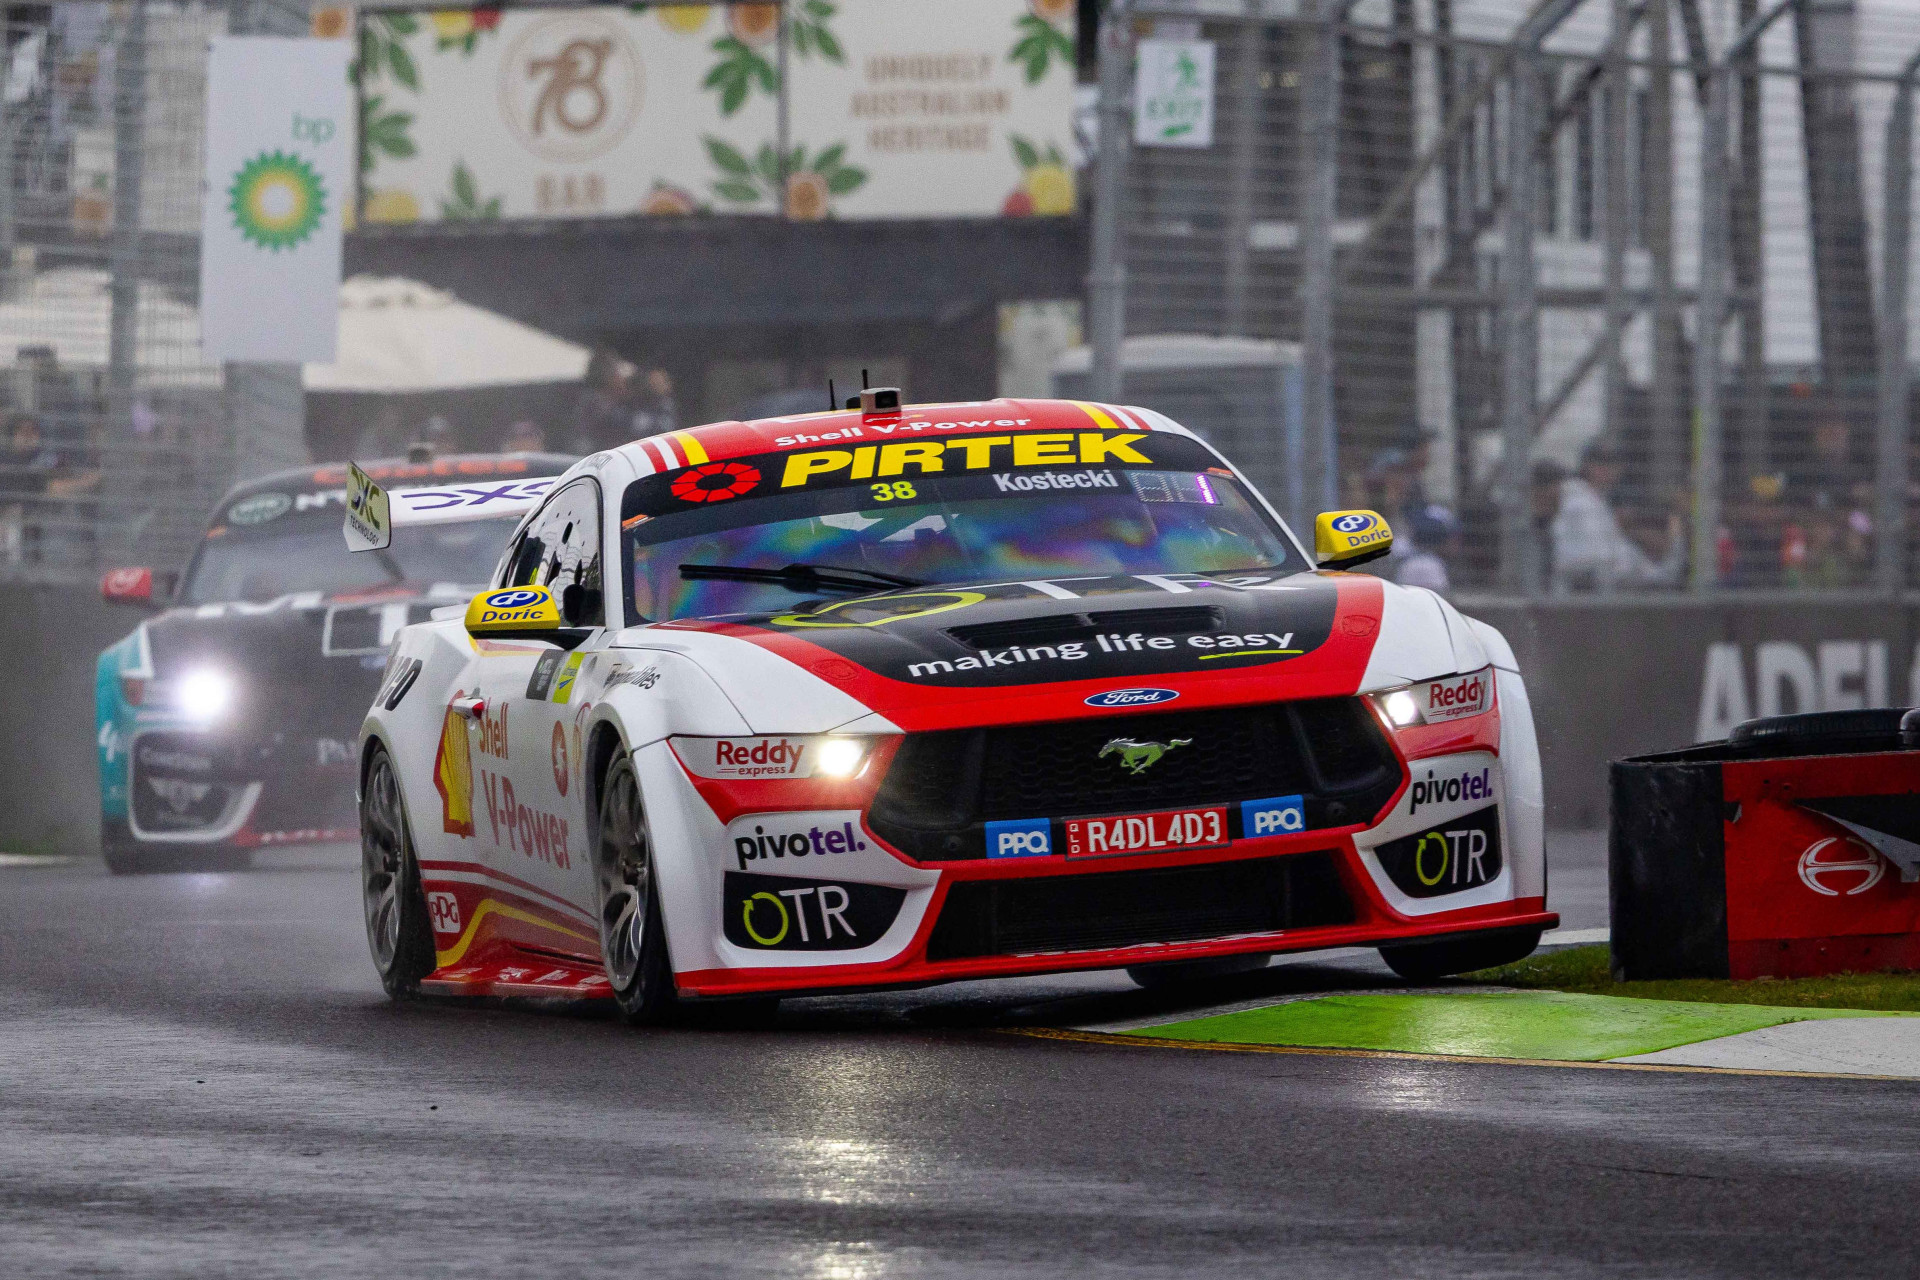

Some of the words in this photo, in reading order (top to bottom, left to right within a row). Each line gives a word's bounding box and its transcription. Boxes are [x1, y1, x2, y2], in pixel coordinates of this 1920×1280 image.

[527, 40, 612, 137] 78
[850, 88, 1013, 118] AUSTRALIAN
[291, 111, 336, 146] bp
[866, 123, 992, 151] HERITAGE
[775, 427, 863, 446] Shell
[870, 417, 1032, 433] V-Power
[780, 433, 1154, 488] PIRTEK
[870, 480, 917, 502] 38
[992, 469, 1118, 493] Kostecki
[350, 514, 380, 547] TECHNOLOGY
[1347, 529, 1390, 547] Doric
[481, 609, 544, 623] Doric
[908, 641, 1086, 677] making
[1101, 632, 1175, 655] life
[1188, 631, 1294, 650] easy
[1102, 689, 1161, 706] Ford
[1429, 676, 1487, 711] Reddy
[1445, 703, 1479, 716] express
[479, 696, 509, 760] Shell
[716, 739, 804, 773] Reddy
[738, 765, 786, 777] express
[481, 769, 571, 870] V-Power
[1087, 811, 1221, 852] R4DL4D3
[1254, 808, 1303, 834] PPQ
[998, 830, 1049, 855] PPQ
[1069, 823, 1081, 854] QLD
[1415, 830, 1486, 886] OTR
[742, 885, 857, 946] OTR
